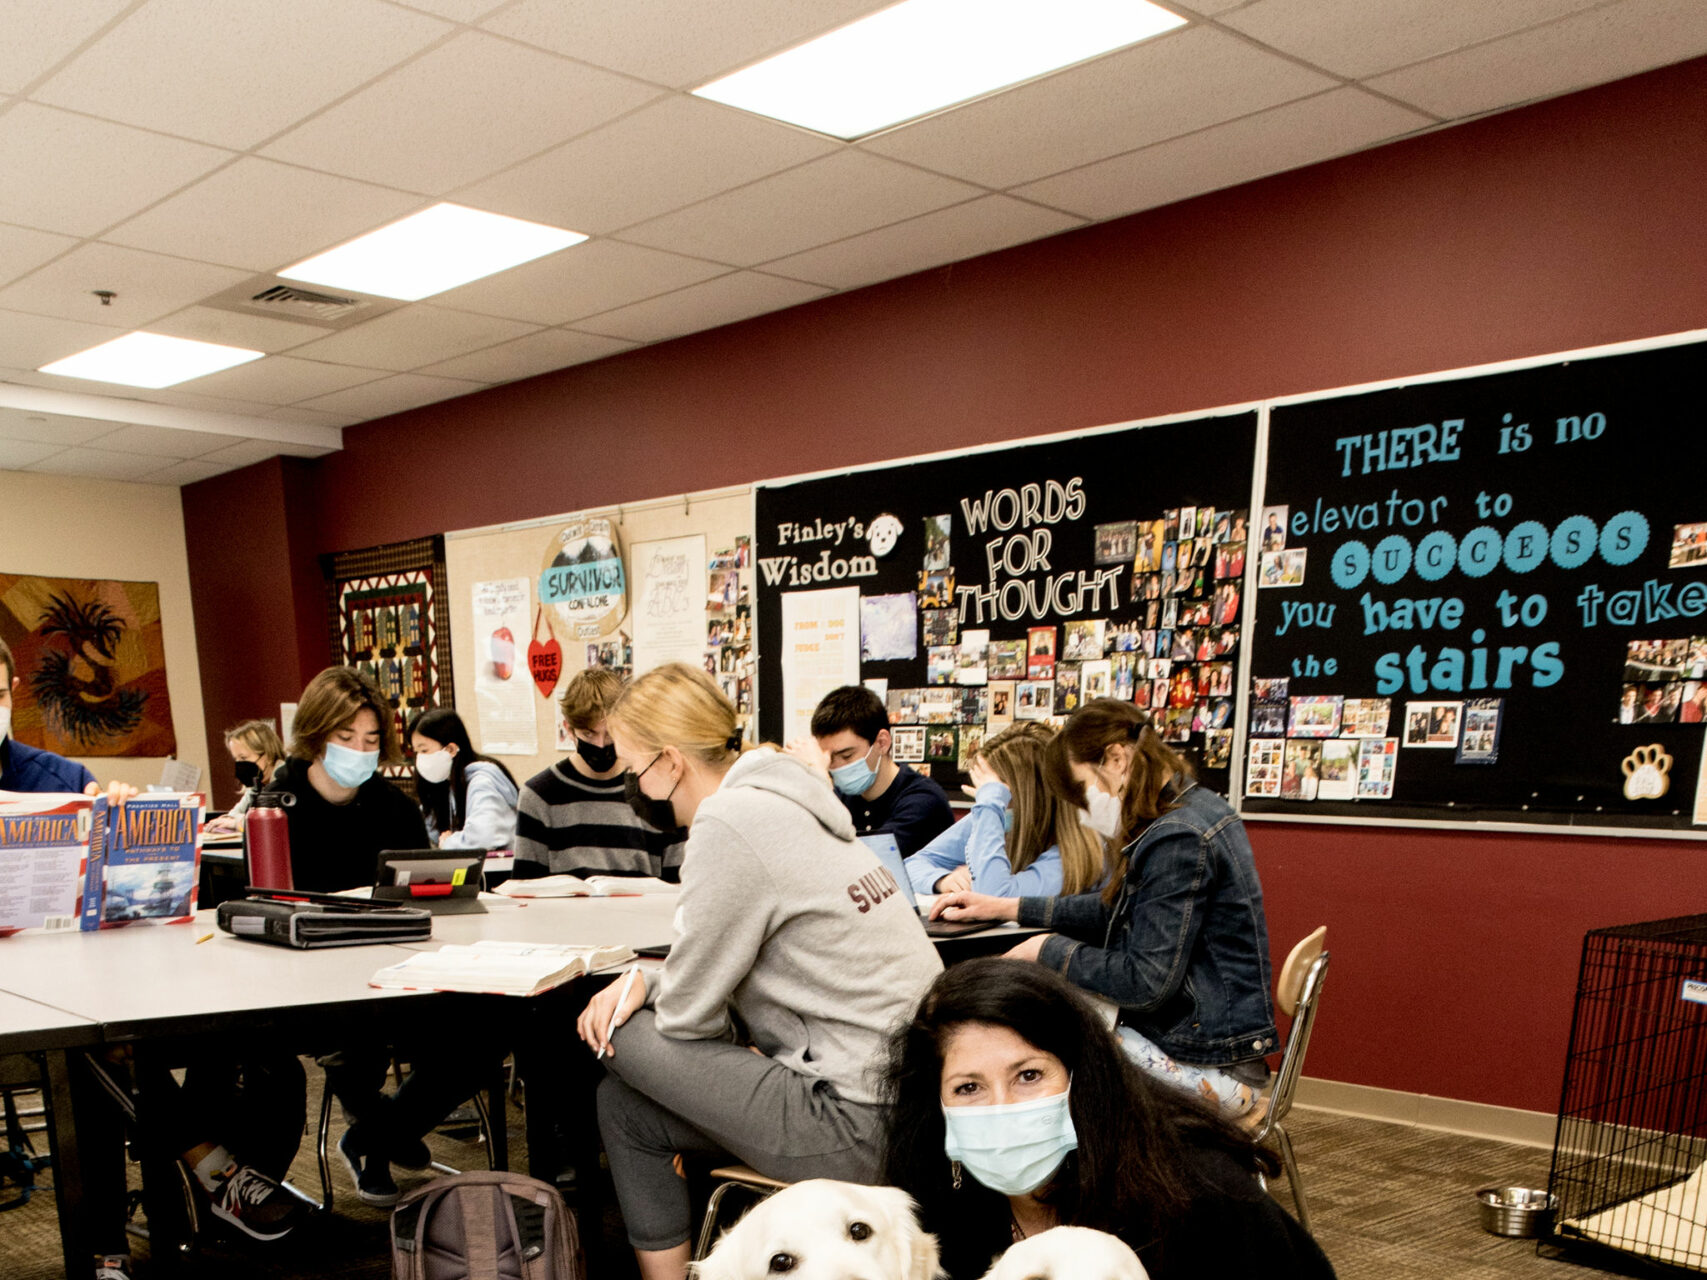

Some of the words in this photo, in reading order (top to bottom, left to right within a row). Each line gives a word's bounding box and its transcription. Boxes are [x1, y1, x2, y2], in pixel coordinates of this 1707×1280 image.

[1336, 418, 1464, 477] THERE
[1498, 412, 1532, 454] is
[1555, 412, 1606, 444] no
[777, 516, 864, 546] Finley's
[960, 477, 1086, 536] WORDS
[1291, 489, 1448, 536] elevator
[1475, 490, 1513, 519] to
[758, 550, 878, 586] Wisdom
[985, 528, 1052, 582] FOR
[1337, 516, 1644, 584] SUCCESS
[548, 565, 622, 598] SURVIVOR
[955, 565, 1125, 624] THOUGHT
[1275, 600, 1336, 635] you
[1361, 592, 1464, 635] have
[1496, 589, 1548, 627] to
[1577, 579, 1707, 628] take
[532, 653, 557, 668] FREE
[533, 669, 557, 682] HUGS
[1291, 655, 1338, 678] the
[1374, 628, 1564, 695] stairs
[114, 805, 193, 850] AMERICA
